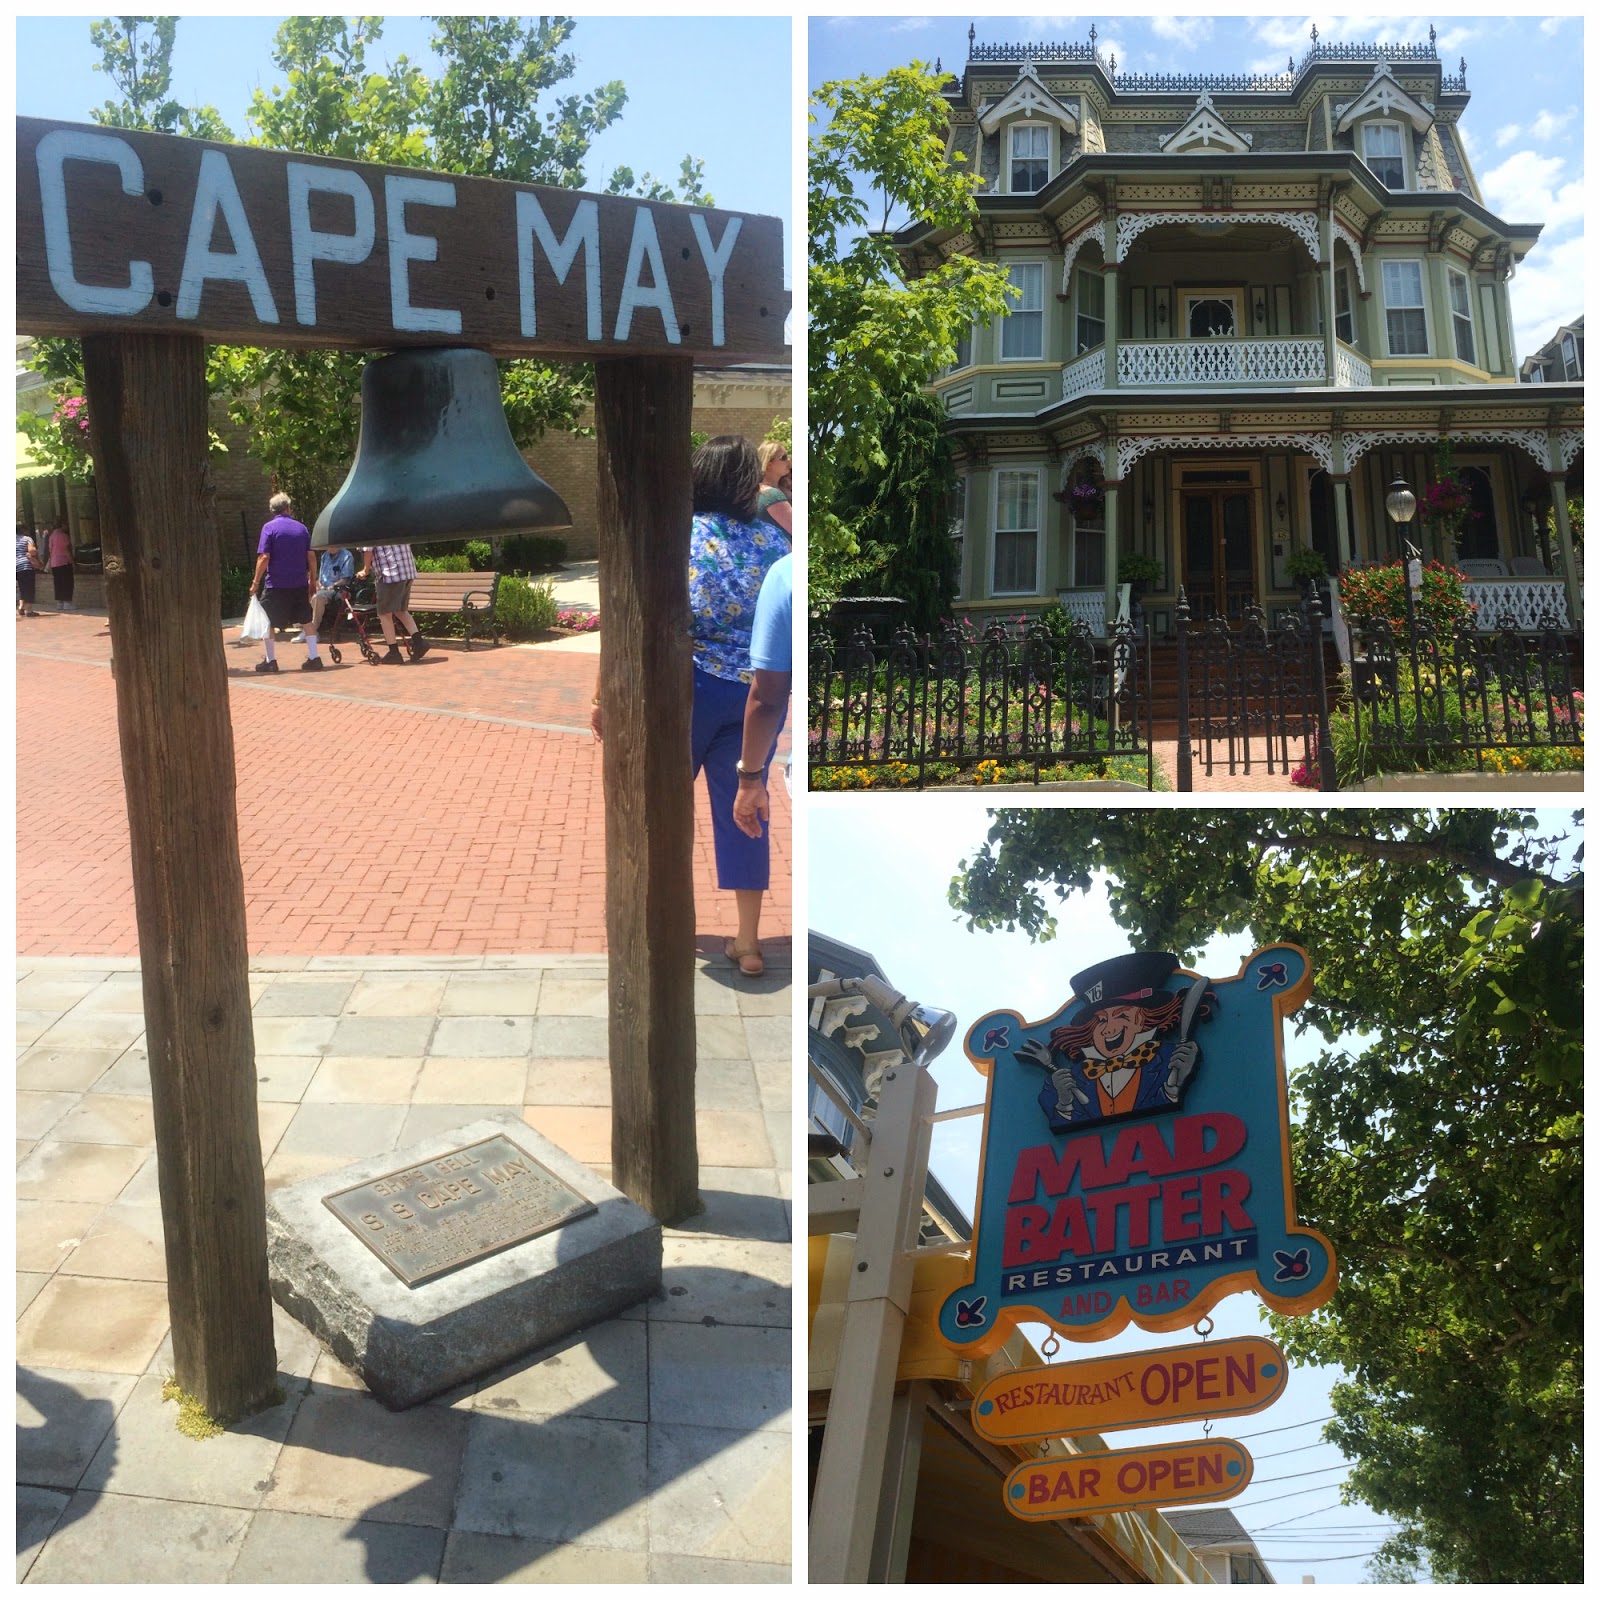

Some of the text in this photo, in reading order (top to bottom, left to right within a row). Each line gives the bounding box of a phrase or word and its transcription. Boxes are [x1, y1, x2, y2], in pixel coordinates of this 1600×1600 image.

[35, 129, 743, 346] CAPE MAY
[417, 1178, 481, 1209] CAPE
[481, 1158, 531, 1185] MAY
[434, 1154, 480, 1175] BELL
[1007, 1111, 1247, 1204] MAD
[1002, 1169, 1257, 1268] BATTER
[1008, 1238, 1249, 1290] RESTAURANT
[1060, 1278, 1192, 1318] AND BAR
[994, 1353, 1257, 1416] RESTAURANT OPEN
[1028, 1453, 1224, 1505] BAR OPEN
